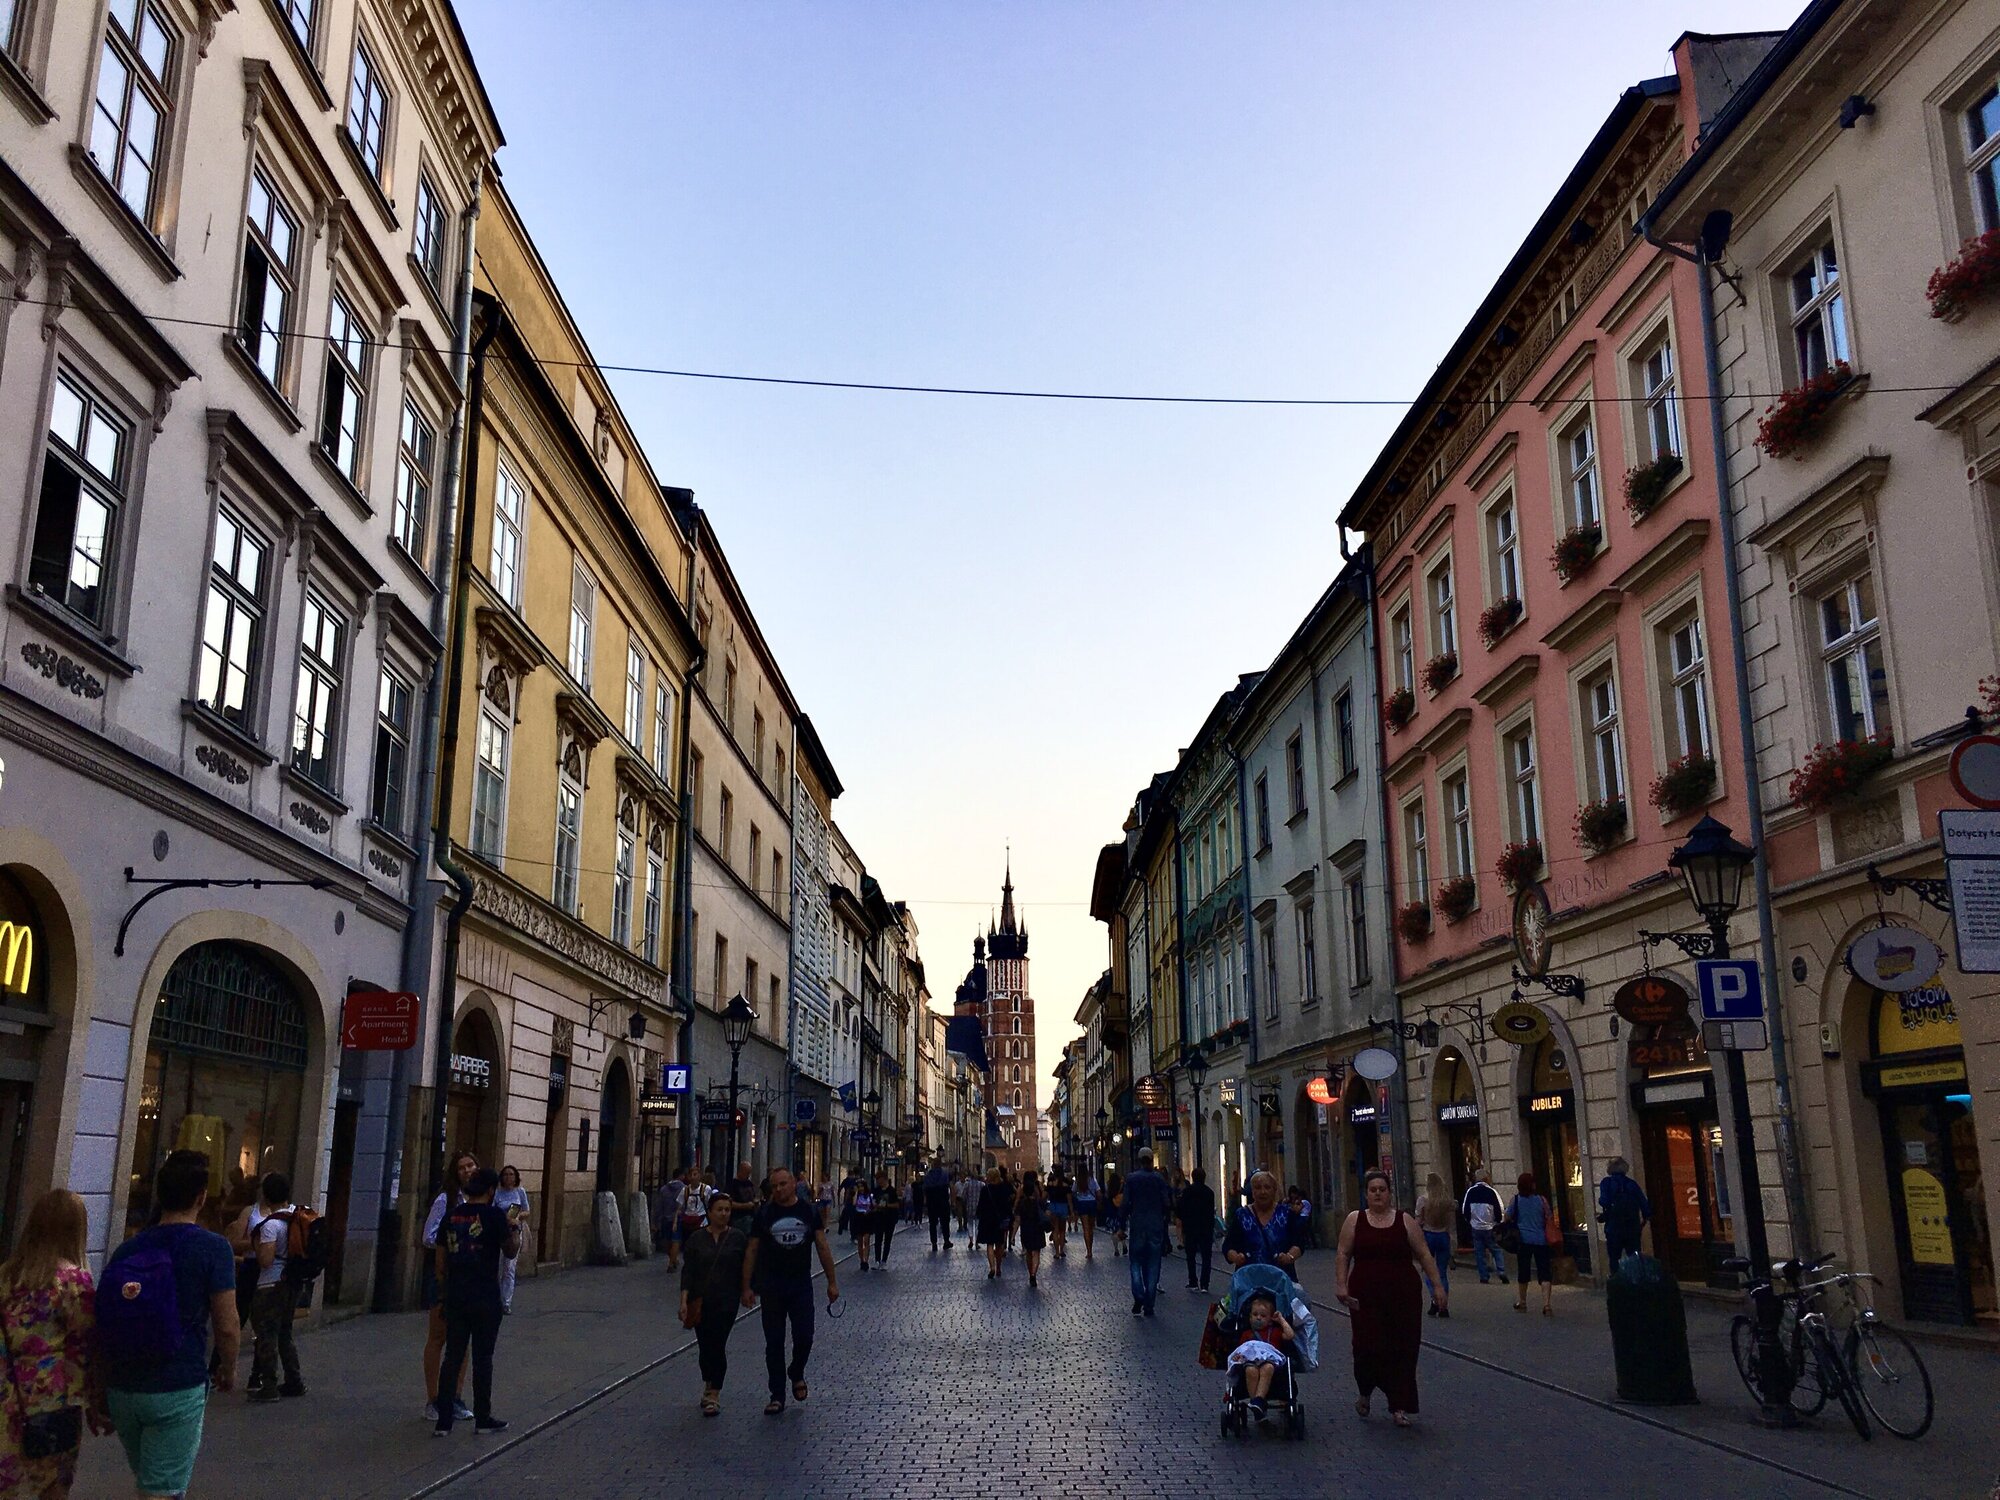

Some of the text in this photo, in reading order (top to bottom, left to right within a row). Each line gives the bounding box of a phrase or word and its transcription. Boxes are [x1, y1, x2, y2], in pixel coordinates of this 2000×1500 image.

[1947, 828, 1988, 840] Dotyczy
[1470, 862, 1609, 937] HOTEL POLSKI
[1711, 967, 1748, 1013] P
[361, 1020, 409, 1030] Apartments
[381, 1035, 409, 1044] Hostel
[453, 1073, 489, 1088] HOES
[1530, 1096, 1563, 1112] JUBILER
[701, 1112, 731, 1121] KEBAB
